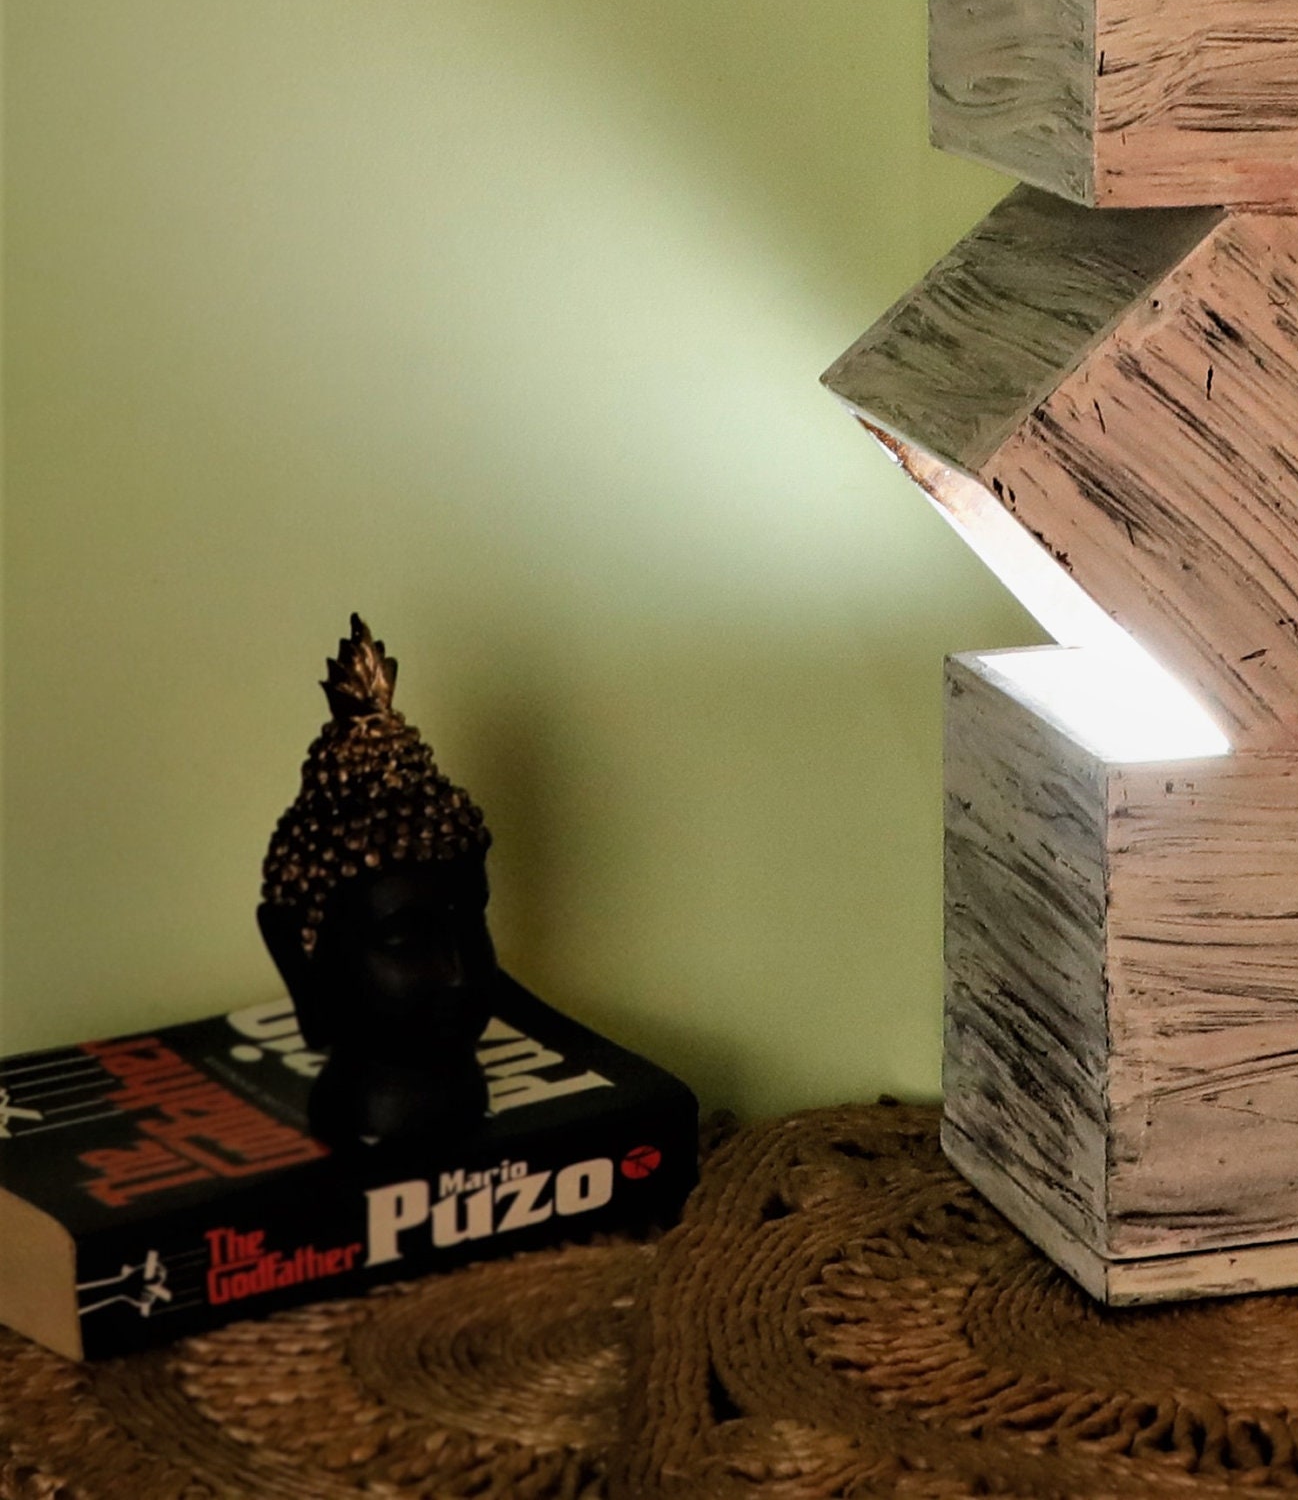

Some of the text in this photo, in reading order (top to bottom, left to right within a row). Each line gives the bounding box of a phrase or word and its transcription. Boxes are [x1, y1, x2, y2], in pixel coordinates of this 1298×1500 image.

[78, 1036, 333, 1177] Godfather
[77, 1139, 217, 1208] The
[439, 1159, 528, 1198] Mario
[364, 1156, 614, 1267] Puzo
[204, 1227, 266, 1267] The
[206, 1242, 362, 1305] Godfather
